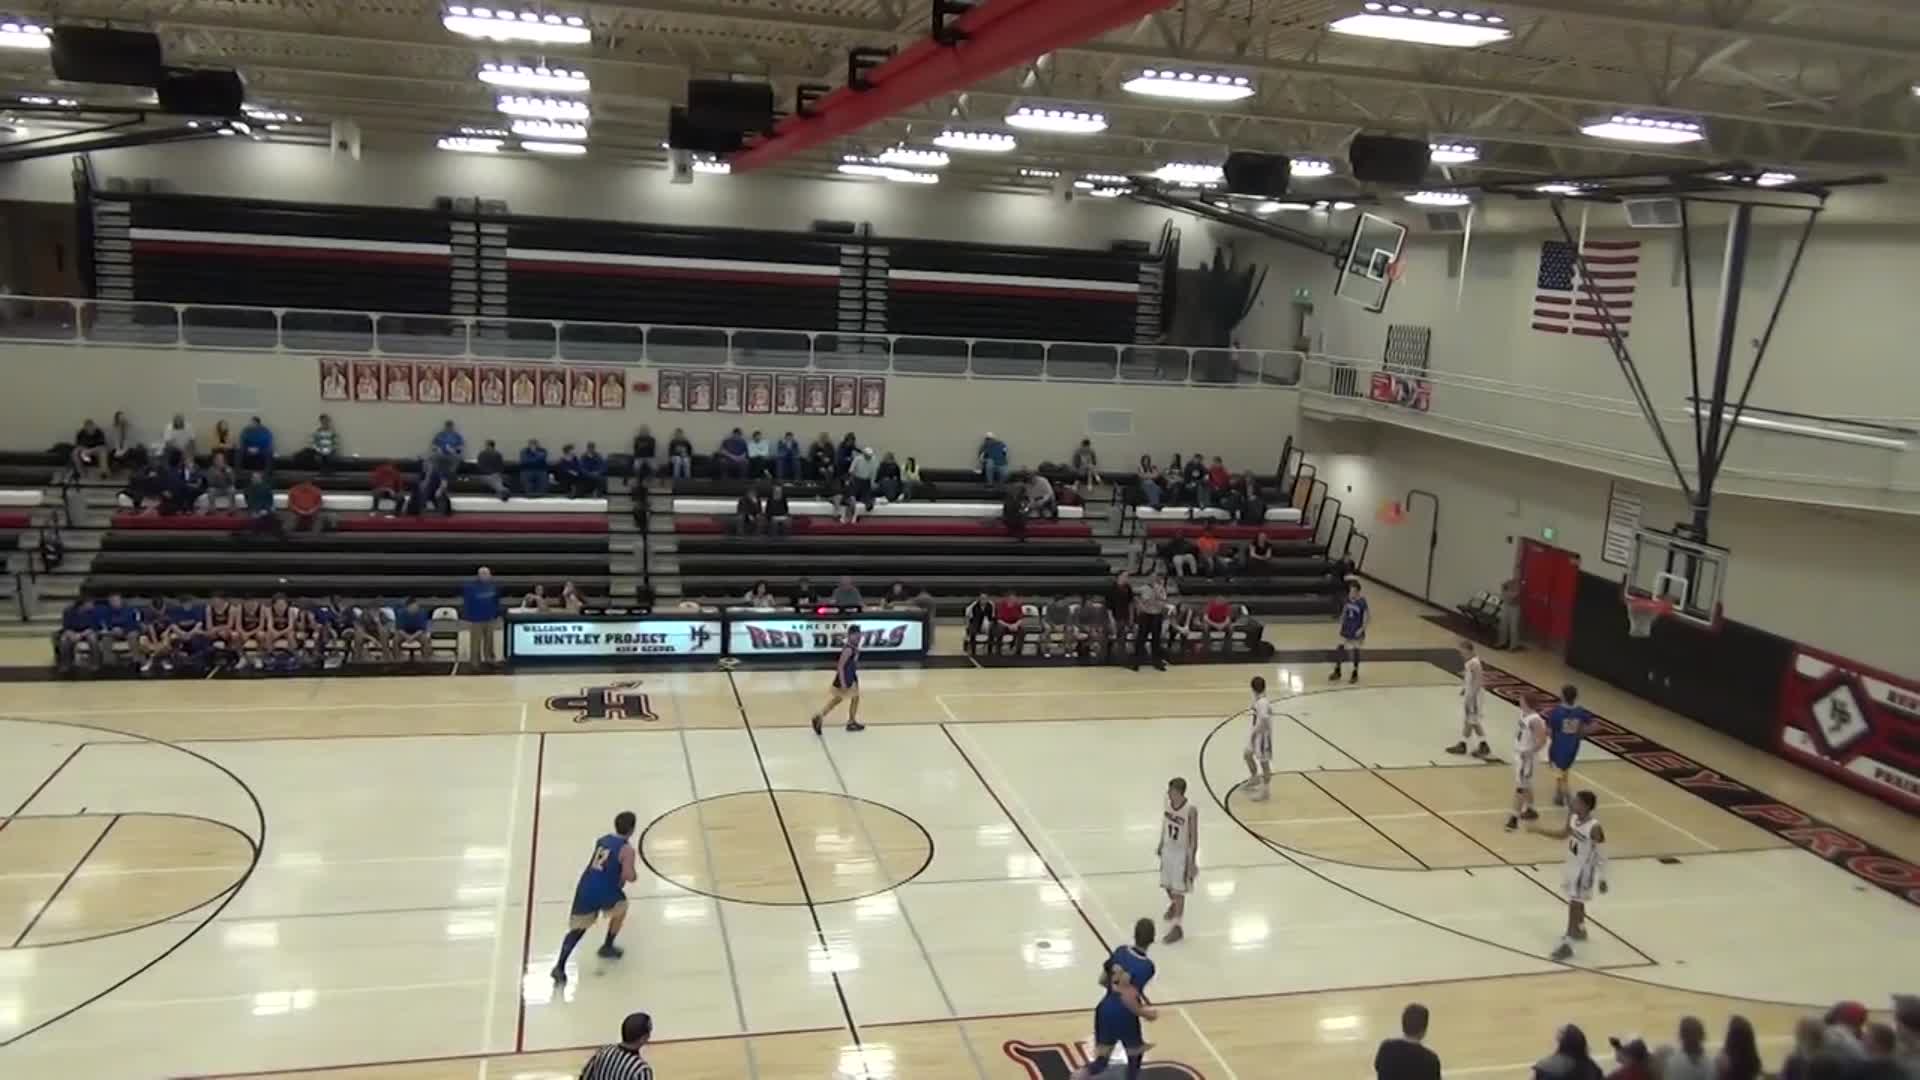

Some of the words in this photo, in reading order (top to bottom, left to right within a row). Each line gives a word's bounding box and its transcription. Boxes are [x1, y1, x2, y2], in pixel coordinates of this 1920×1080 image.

[533, 633, 600, 645] HUNTLEY
[605, 632, 667, 645] PROJECT
[745, 625, 803, 649] RED
[812, 624, 908, 649] DEILS
